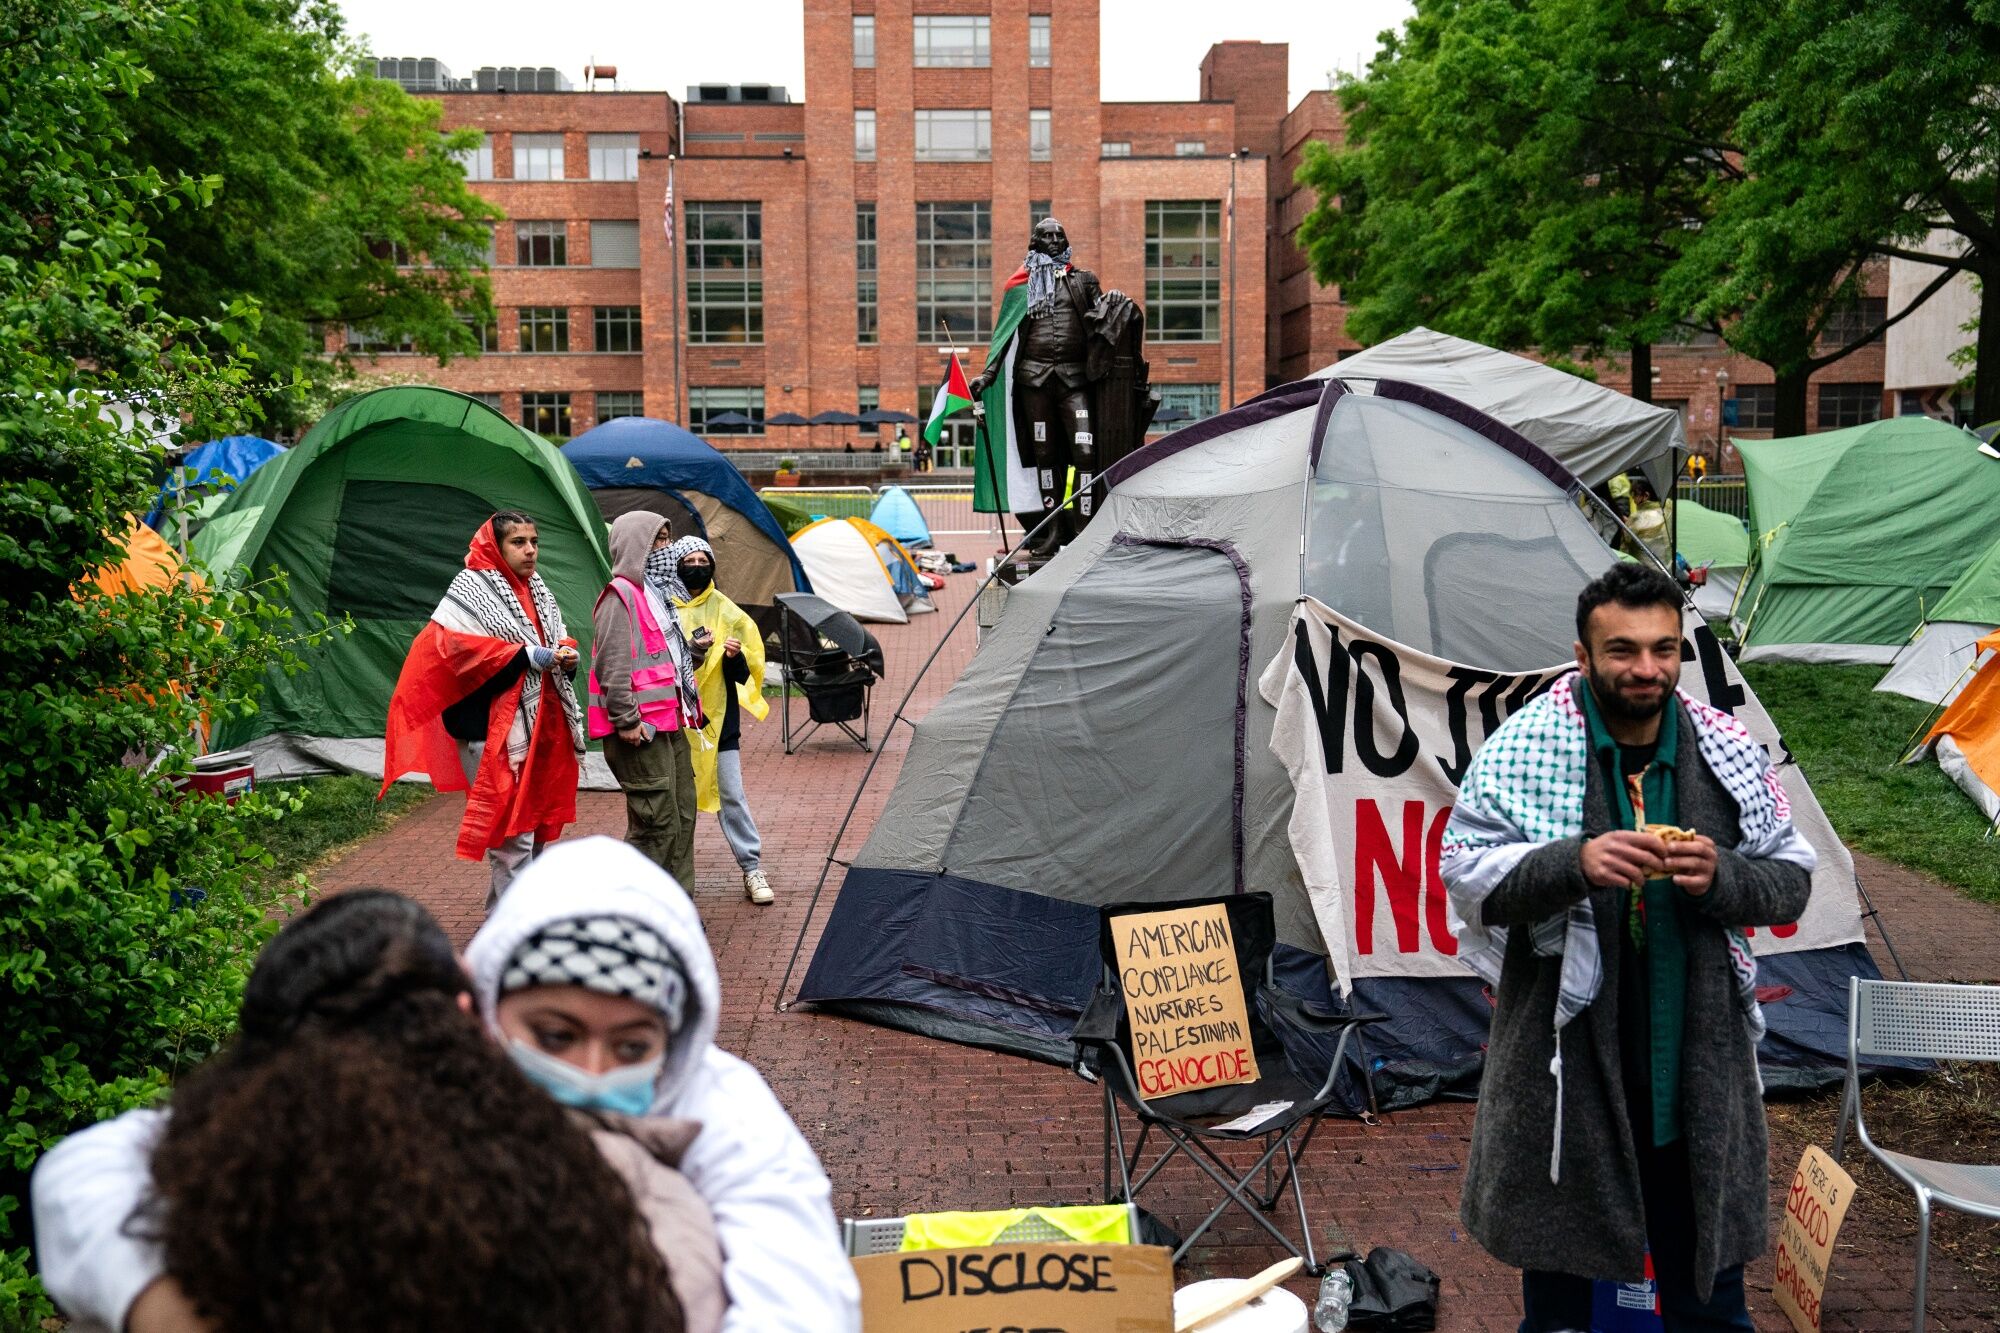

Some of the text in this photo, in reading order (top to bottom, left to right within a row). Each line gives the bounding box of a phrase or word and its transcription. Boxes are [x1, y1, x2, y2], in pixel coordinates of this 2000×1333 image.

[1295, 618, 1419, 778] NO
[1128, 918, 1229, 959] AMERICAN
[1135, 995, 1223, 1026] NURTURES
[1135, 1021, 1242, 1057] PALESTINIAN
[1138, 1048, 1251, 1094] GENOCIDE
[1806, 1155, 1838, 1205] THERE IS
[1788, 1171, 1829, 1247] BLOOD
[900, 1252, 1117, 1303] DISCLOSE
